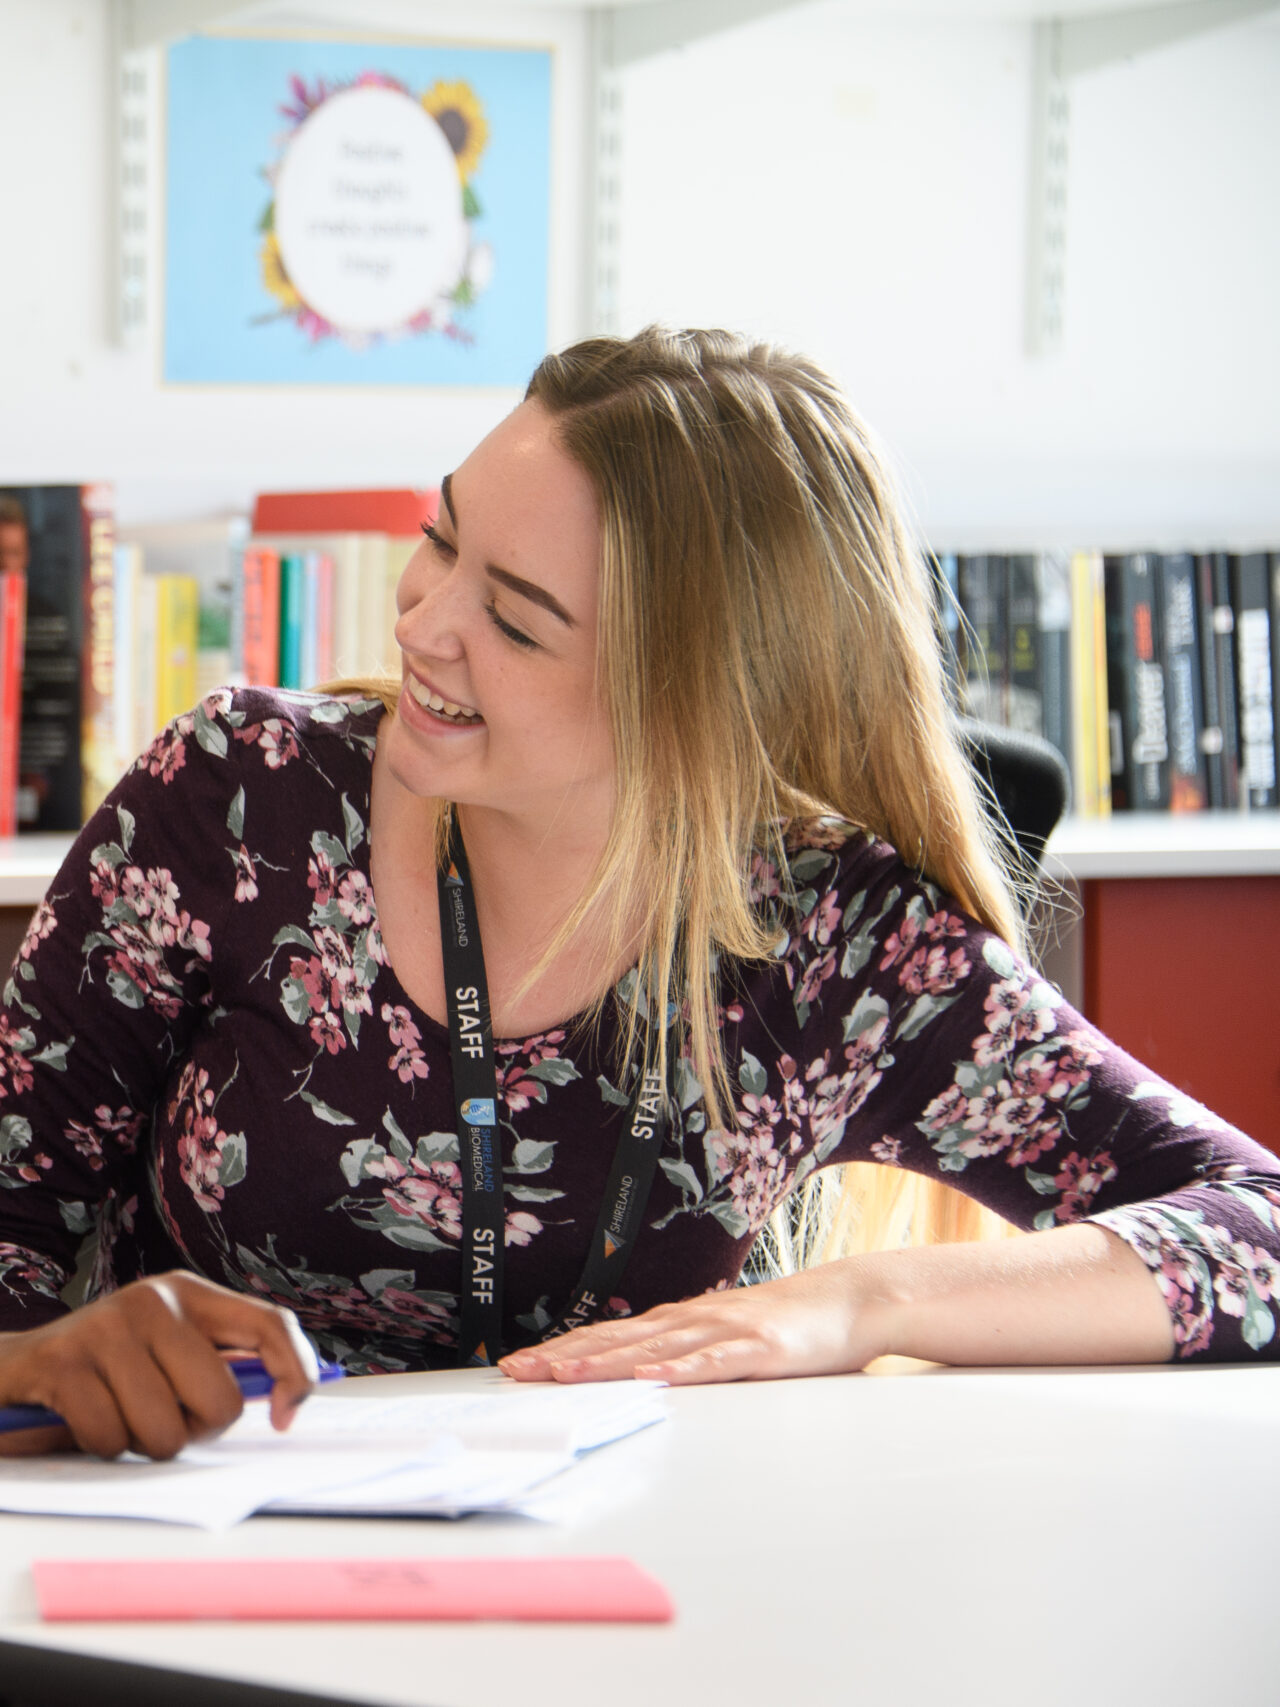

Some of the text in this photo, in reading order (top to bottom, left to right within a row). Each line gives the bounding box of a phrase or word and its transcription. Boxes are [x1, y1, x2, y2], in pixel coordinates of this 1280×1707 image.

[452, 887, 469, 948] SHIRELAND
[455, 986, 484, 1059] STAFF
[631, 1068, 665, 1141] STAFF
[470, 1126, 485, 1192] BIOMEDICAL
[480, 1127, 495, 1193] SHIRELAND
[609, 1175, 634, 1233] SHIRELAND
[472, 1227, 495, 1305] STAFF
